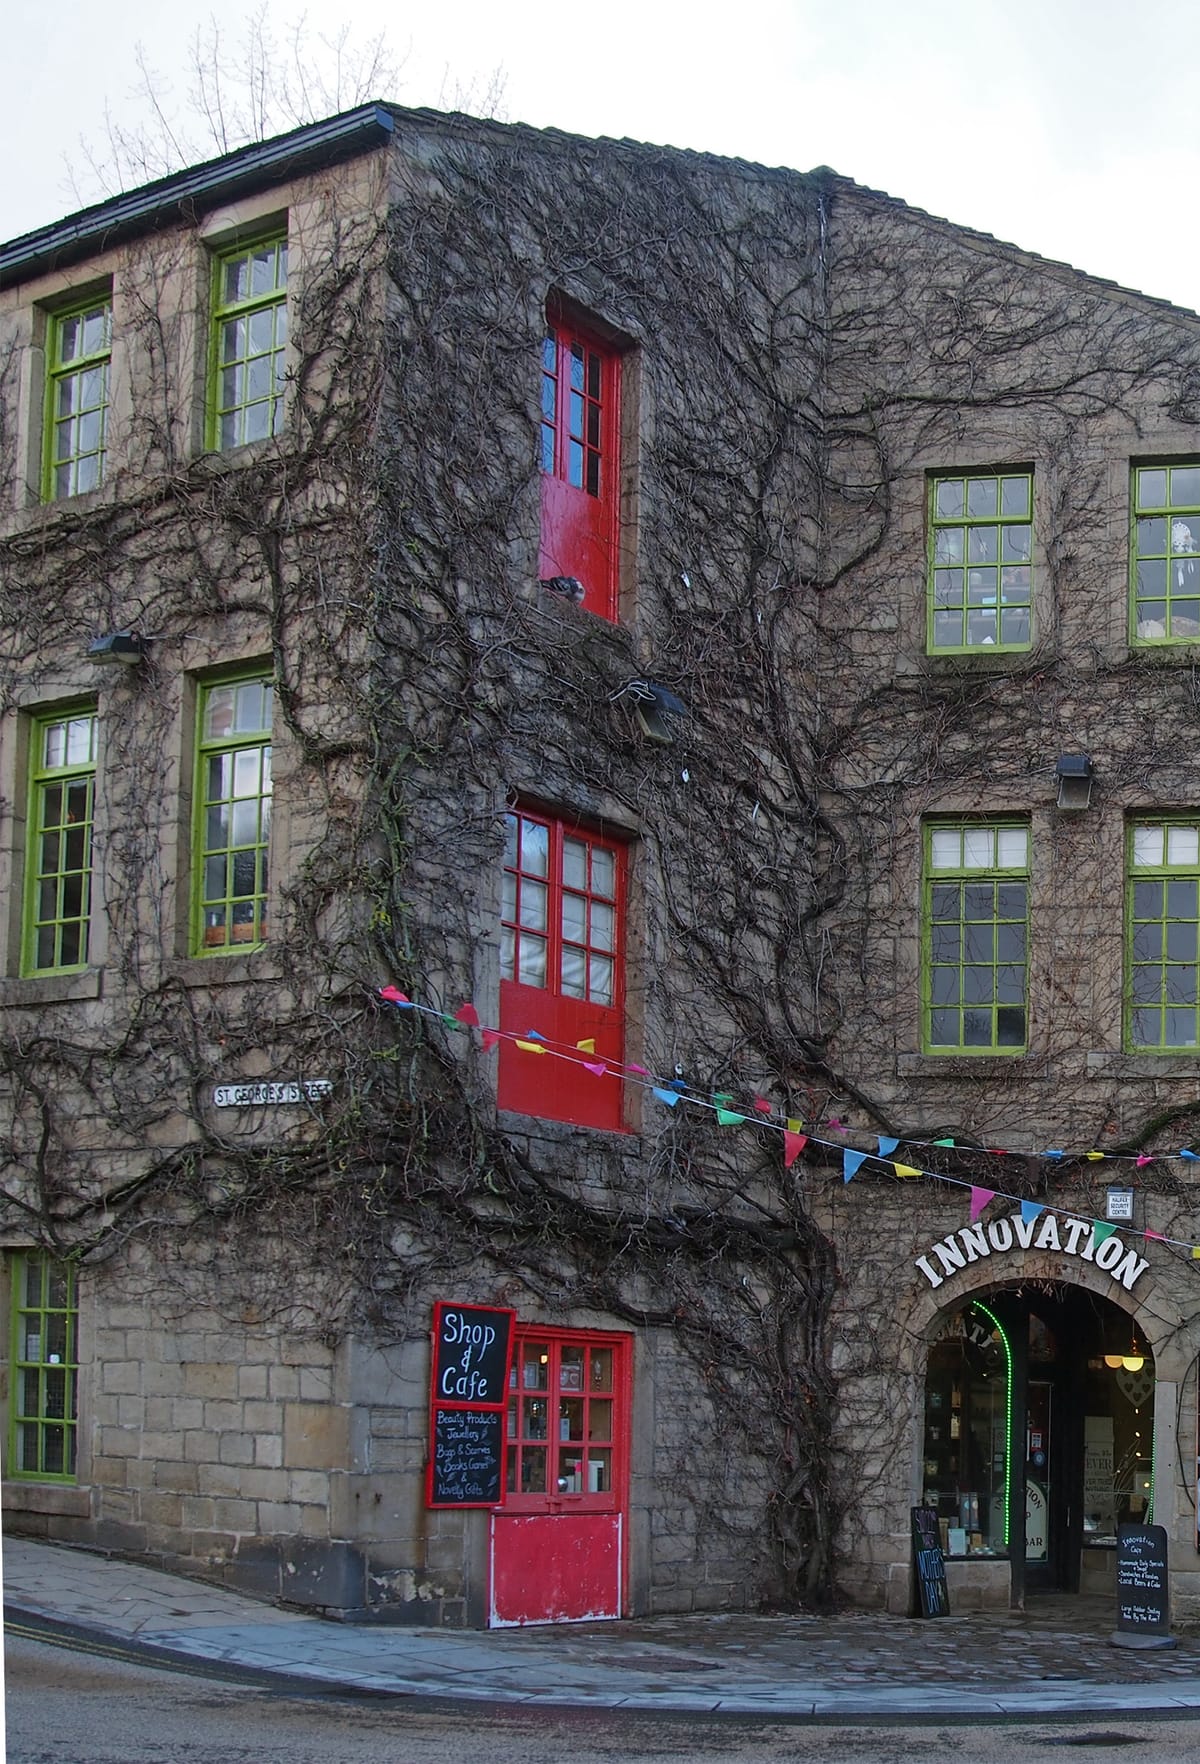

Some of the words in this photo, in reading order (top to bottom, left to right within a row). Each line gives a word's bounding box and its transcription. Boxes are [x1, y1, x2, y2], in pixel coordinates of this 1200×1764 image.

[915, 1214, 1150, 1292] INNOVATION
[444, 1313, 495, 1362] Shop
[442, 1367, 487, 1400] Cafe
[437, 1410, 465, 1427] Beauty
[466, 1411, 497, 1425] Products
[1122, 1535, 1155, 1549] Innovation
